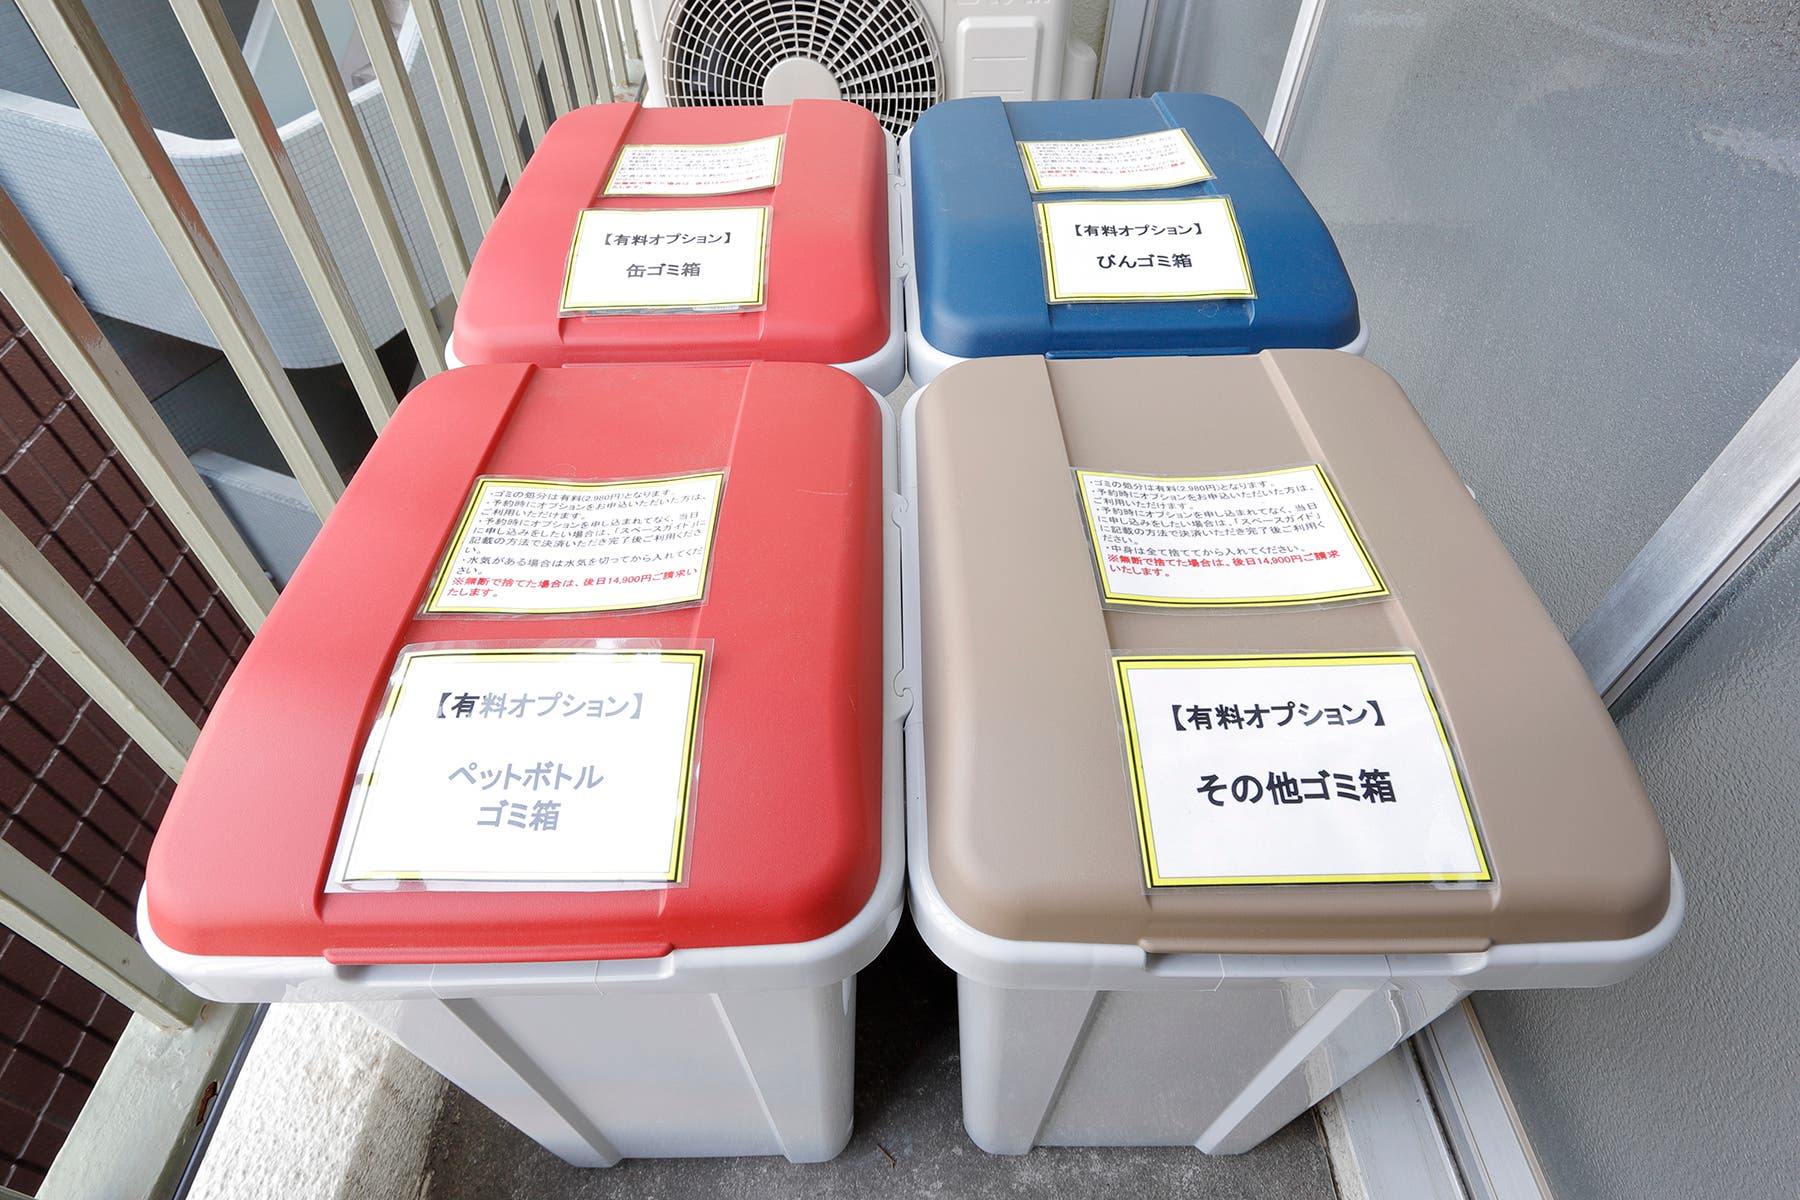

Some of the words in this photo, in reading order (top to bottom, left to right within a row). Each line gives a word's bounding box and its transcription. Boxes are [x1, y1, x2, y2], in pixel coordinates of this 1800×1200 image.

[1074, 222, 1203, 237] 【有料オプション】
[604, 232, 732, 246] 【有料オプション】
[1096, 253, 1193, 269] びんゴミ箱
[626, 261, 701, 278] 缶ゴミ箱
[1103, 534, 1138, 545] ださい。
[464, 546, 481, 554] い。
[456, 567, 483, 575] さい。
[1110, 564, 1170, 577] いたします。
[447, 588, 498, 598] たします。
[435, 691, 644, 719] 【有料オプション】
[1171, 700, 1386, 731] 【有料オプション】
[448, 761, 604, 791] ペットボトル
[1197, 768, 1397, 807] その他ゴミ箱
[476, 799, 562, 831] ゴミ箱
